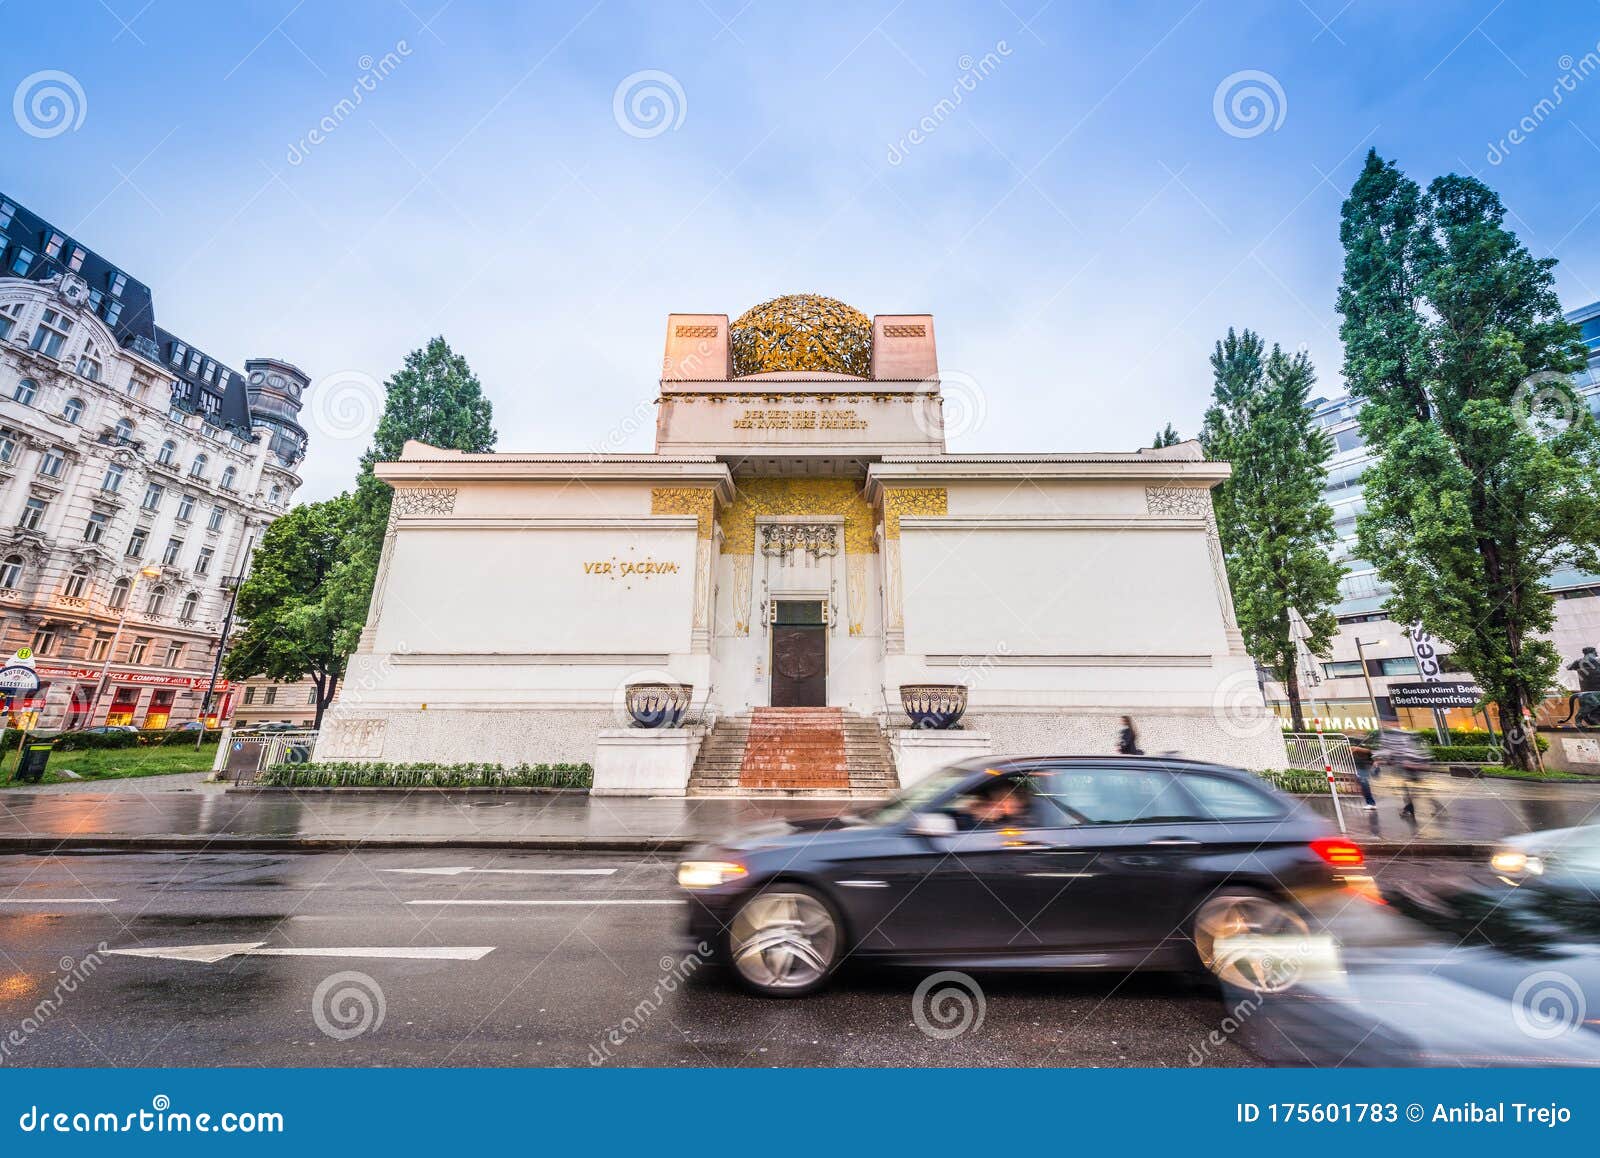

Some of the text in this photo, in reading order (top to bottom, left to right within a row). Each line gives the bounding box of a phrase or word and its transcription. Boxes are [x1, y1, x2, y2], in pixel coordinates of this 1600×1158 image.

[744, 410, 765, 419] DER
[733, 420, 753, 429] DER
[583, 562, 612, 574] VER
[4, 669, 32, 679] AUTOBUS
[93, 672, 130, 680] BYCLE
[132, 675, 171, 683] COMPANY
[1396, 695, 1473, 704] Beethovenfries
